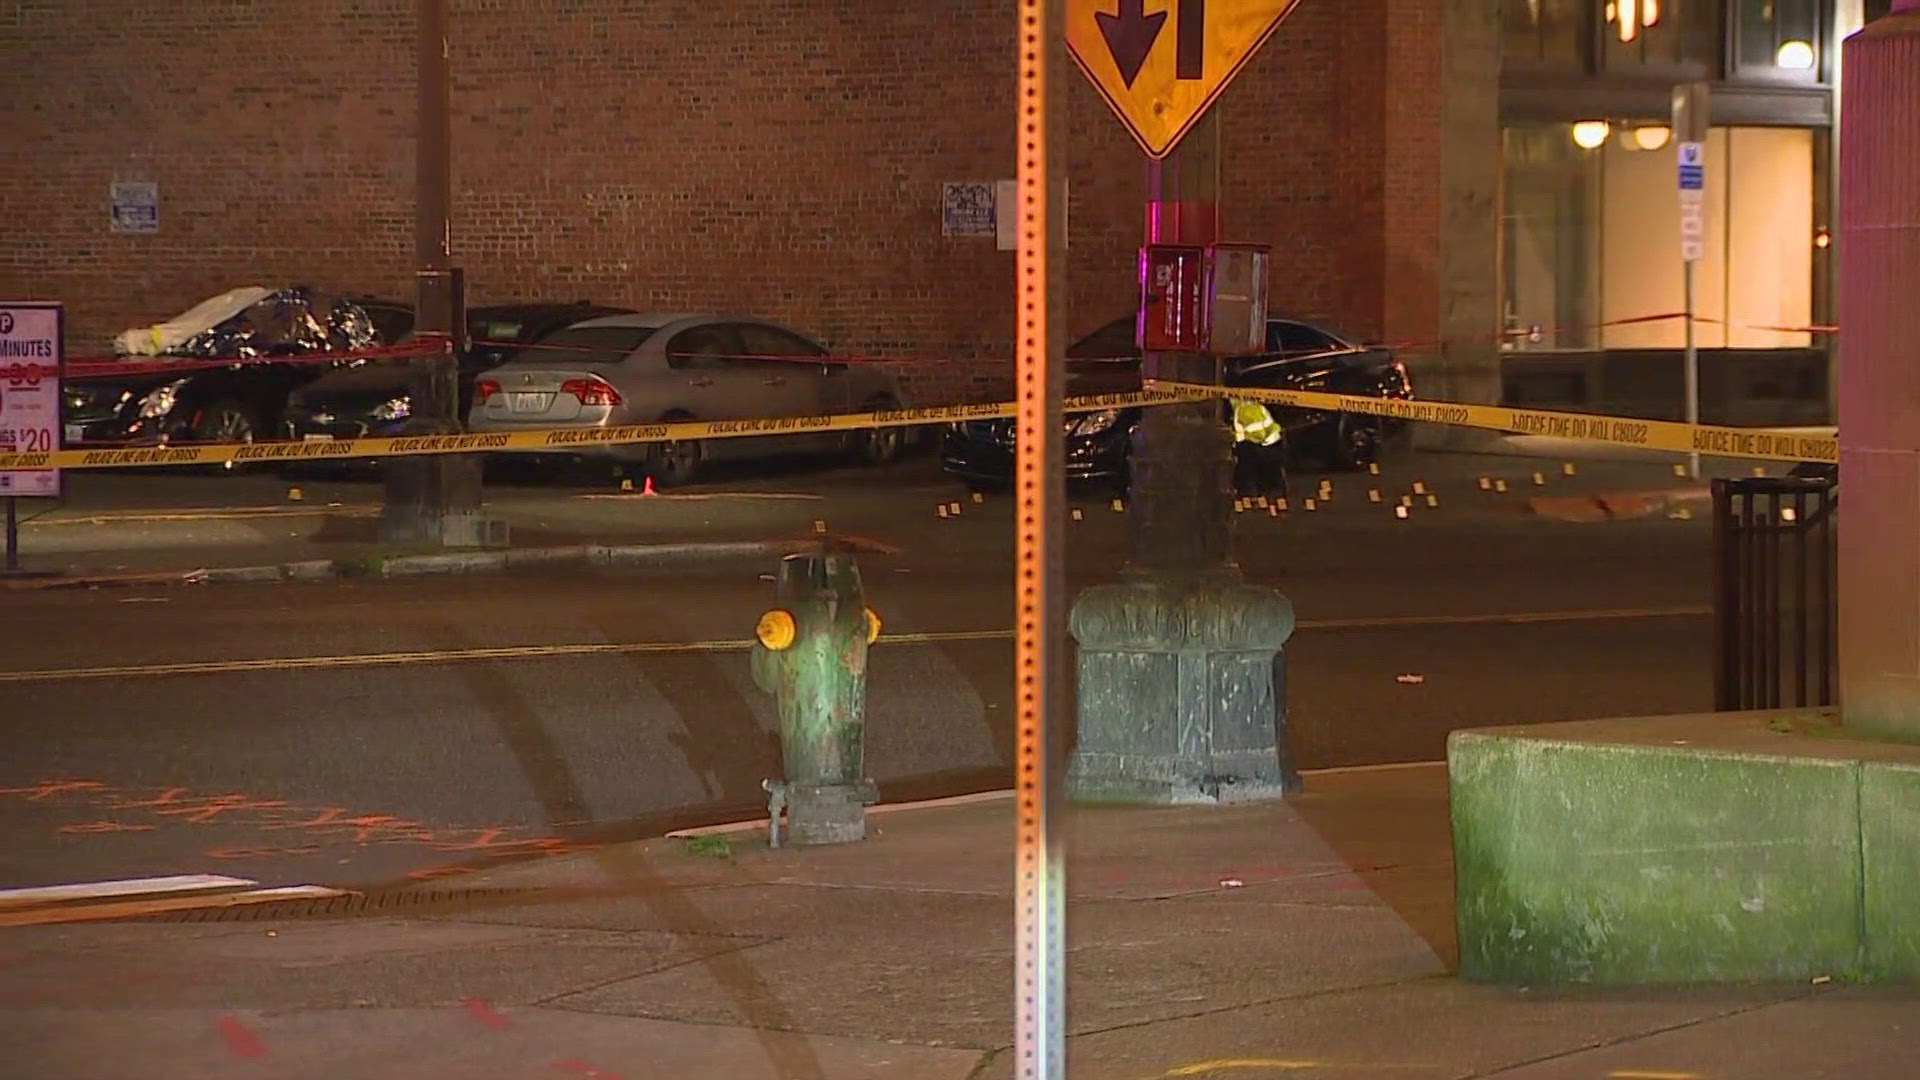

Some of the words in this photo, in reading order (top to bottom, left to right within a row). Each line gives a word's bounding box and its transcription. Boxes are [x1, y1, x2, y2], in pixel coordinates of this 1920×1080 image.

[0, 340, 52, 358] MINUTES
[1079, 394, 1100, 407] LINE
[1119, 391, 1137, 403] NOT
[707, 421, 738, 434] POLICE
[741, 420, 760, 432] LINE
[778, 418, 797, 430] NOT
[800, 416, 831, 428] CROSS
[20, 428, 50, 452] $20
[546, 430, 577, 444] POLICE
[579, 429, 600, 441] LINE
[615, 428, 633, 440] NOT
[636, 426, 668, 439] CROSS
[234, 445, 265, 458] POLICE
[265, 444, 289, 457] LINE
[389, 439, 419, 452] POLICE
[420, 438, 442, 450] LINE
[83, 451, 114, 464] POLICE
